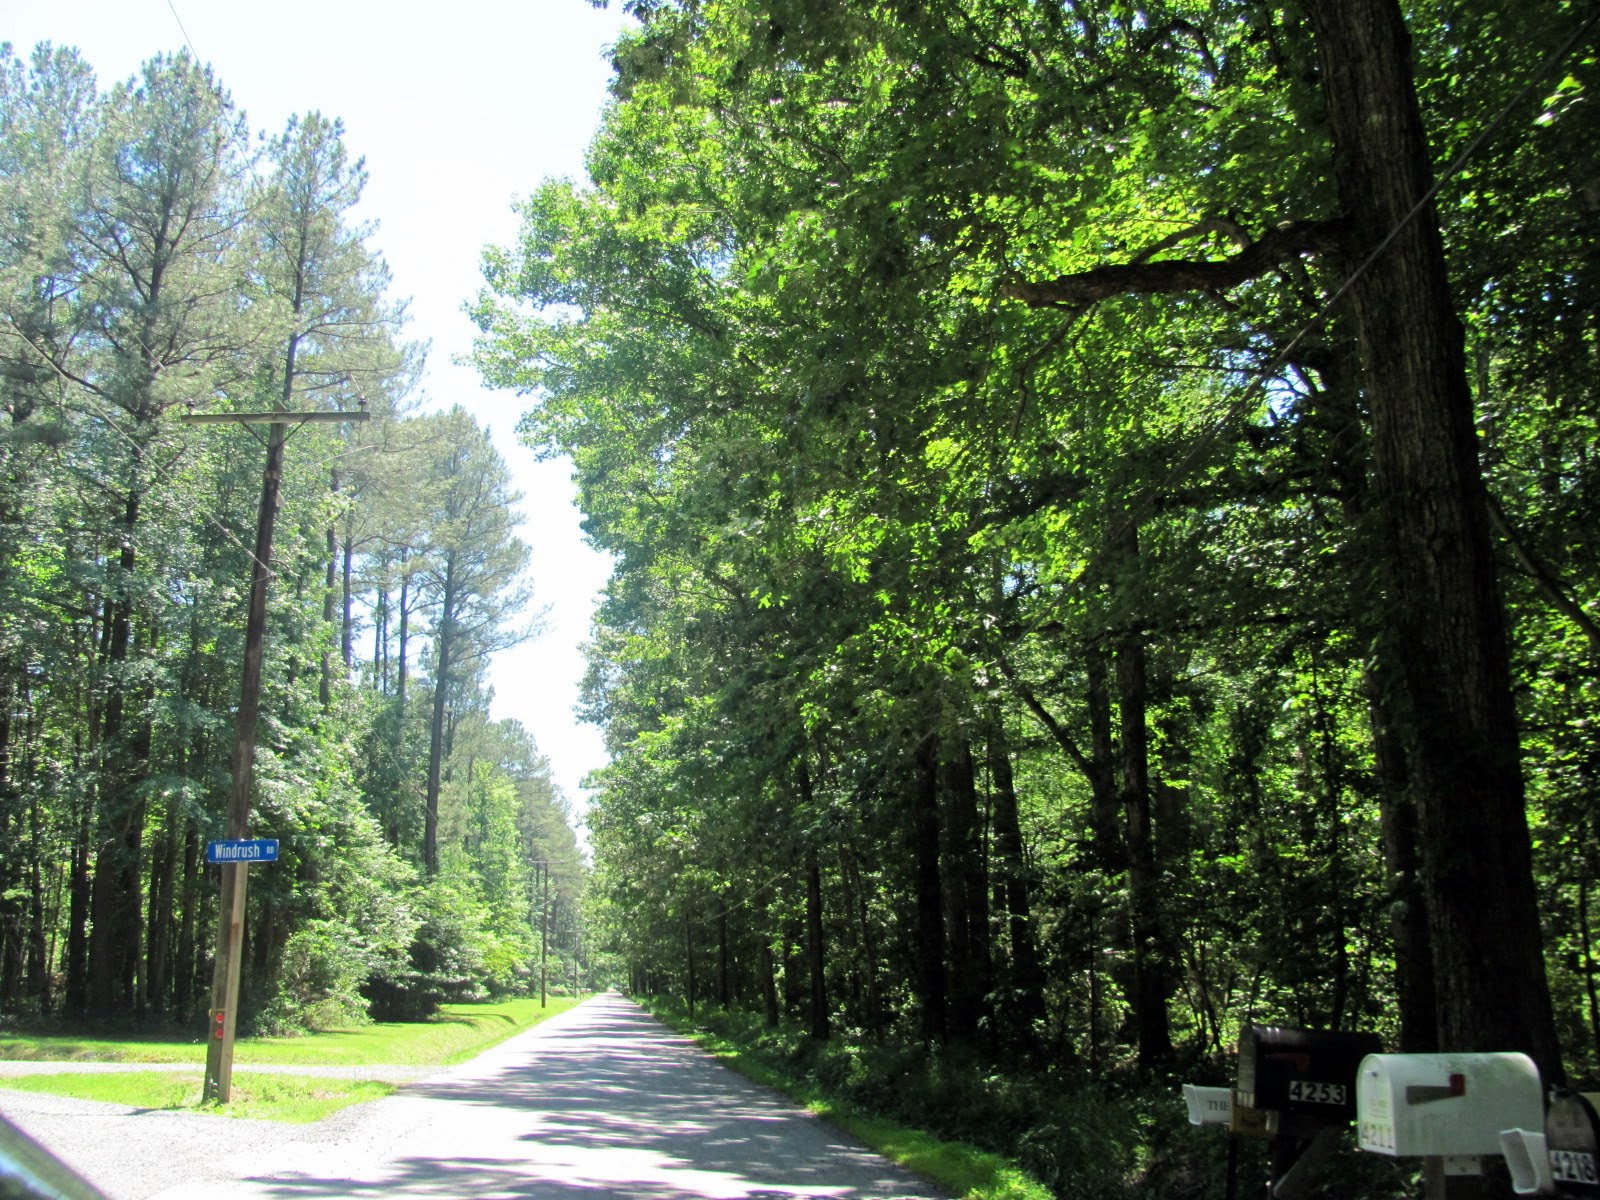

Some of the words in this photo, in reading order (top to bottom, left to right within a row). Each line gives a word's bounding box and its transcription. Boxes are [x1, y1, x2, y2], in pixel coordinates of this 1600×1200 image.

[215, 844, 260, 858] Windrush
[266, 846, 275, 854] RD
[1290, 1081, 1345, 1103] 4253
